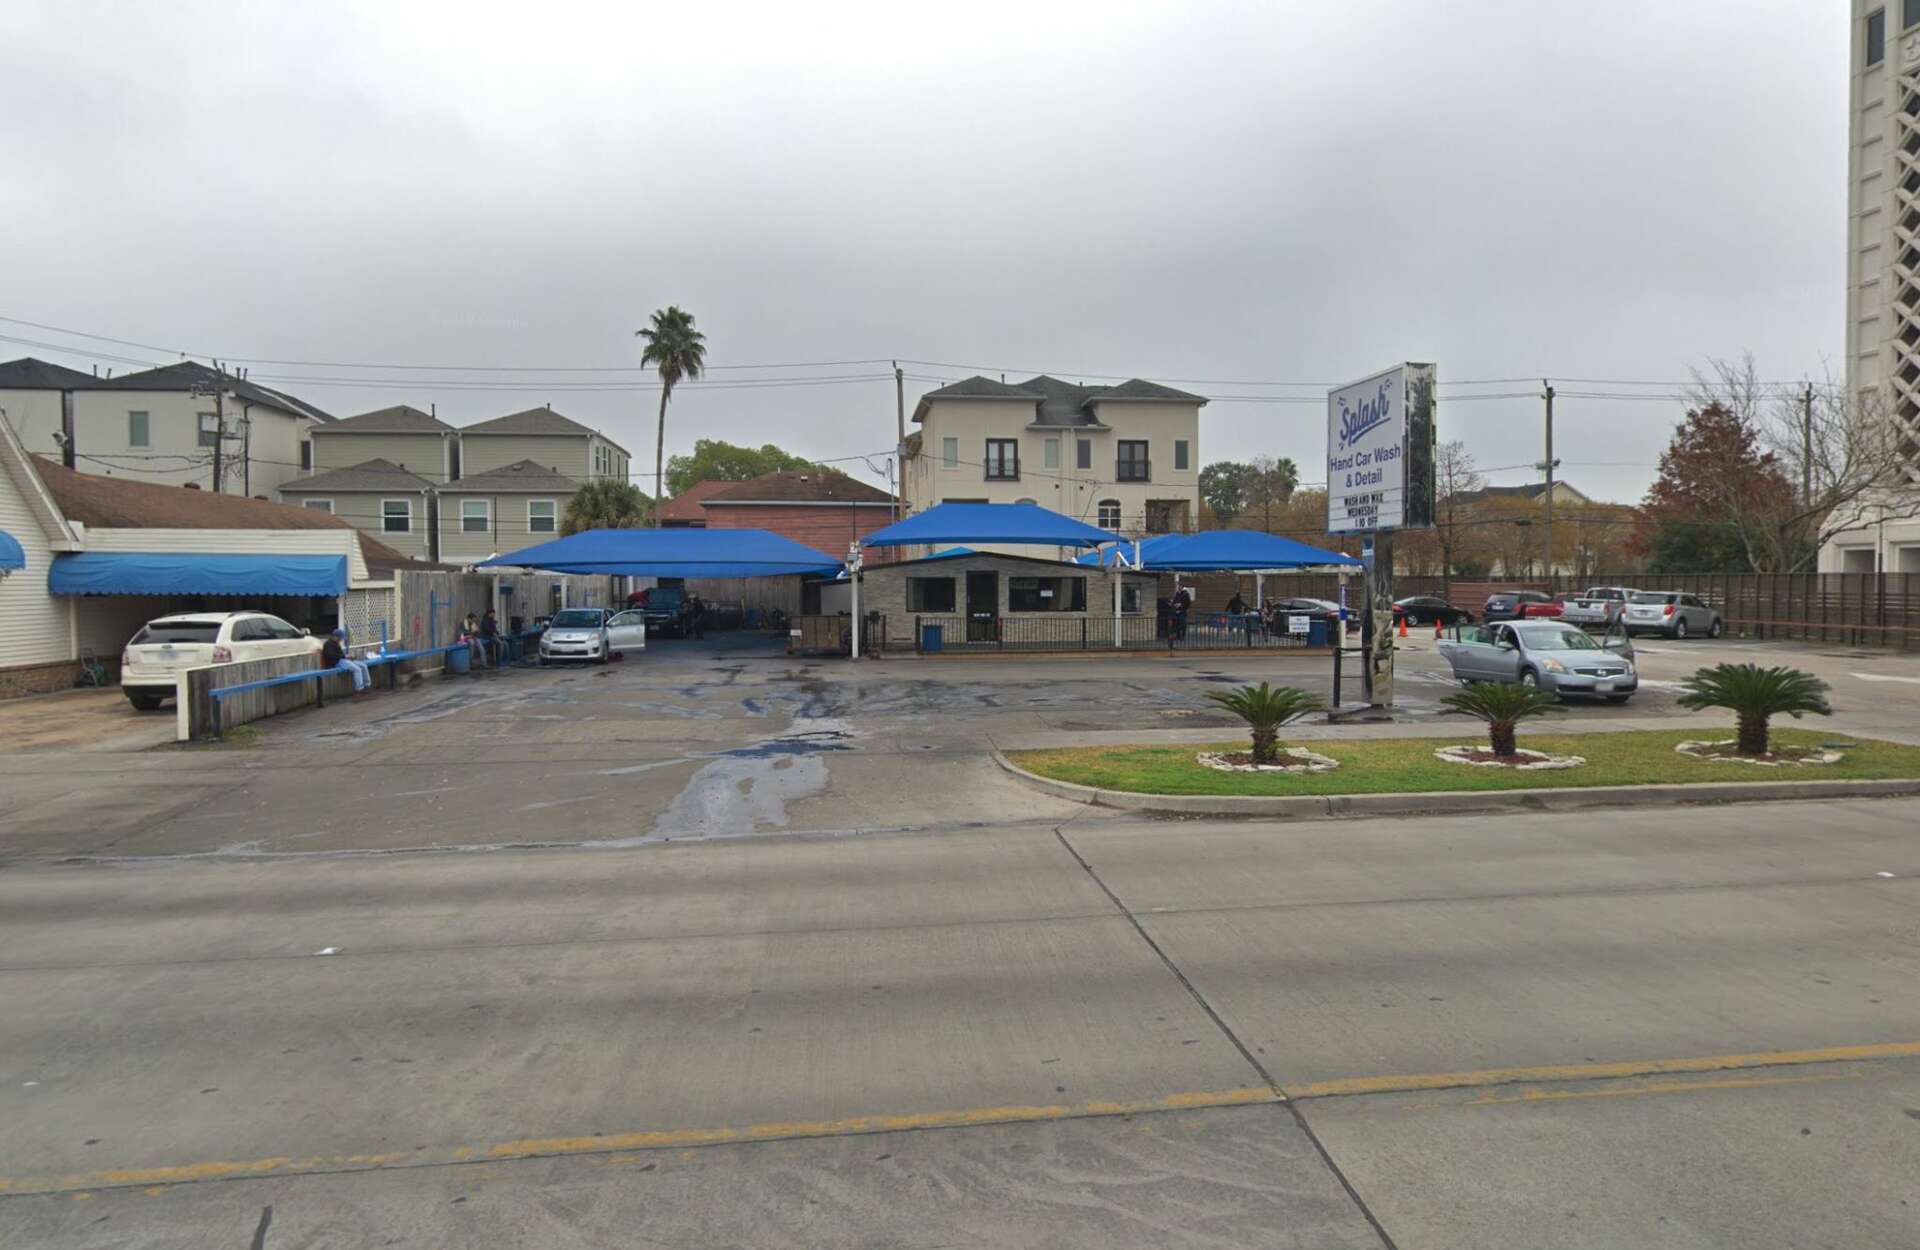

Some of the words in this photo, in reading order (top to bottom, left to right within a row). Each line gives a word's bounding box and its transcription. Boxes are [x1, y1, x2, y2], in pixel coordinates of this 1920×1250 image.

[1340, 385, 1389, 446] Splash
[1330, 453, 1353, 472] Hand
[1356, 452, 1372, 466] Car
[1374, 443, 1400, 463] Wash
[1346, 474, 1352, 488] &
[1355, 468, 1382, 486] Detail
[1347, 505, 1378, 518] WEDNESDAY
